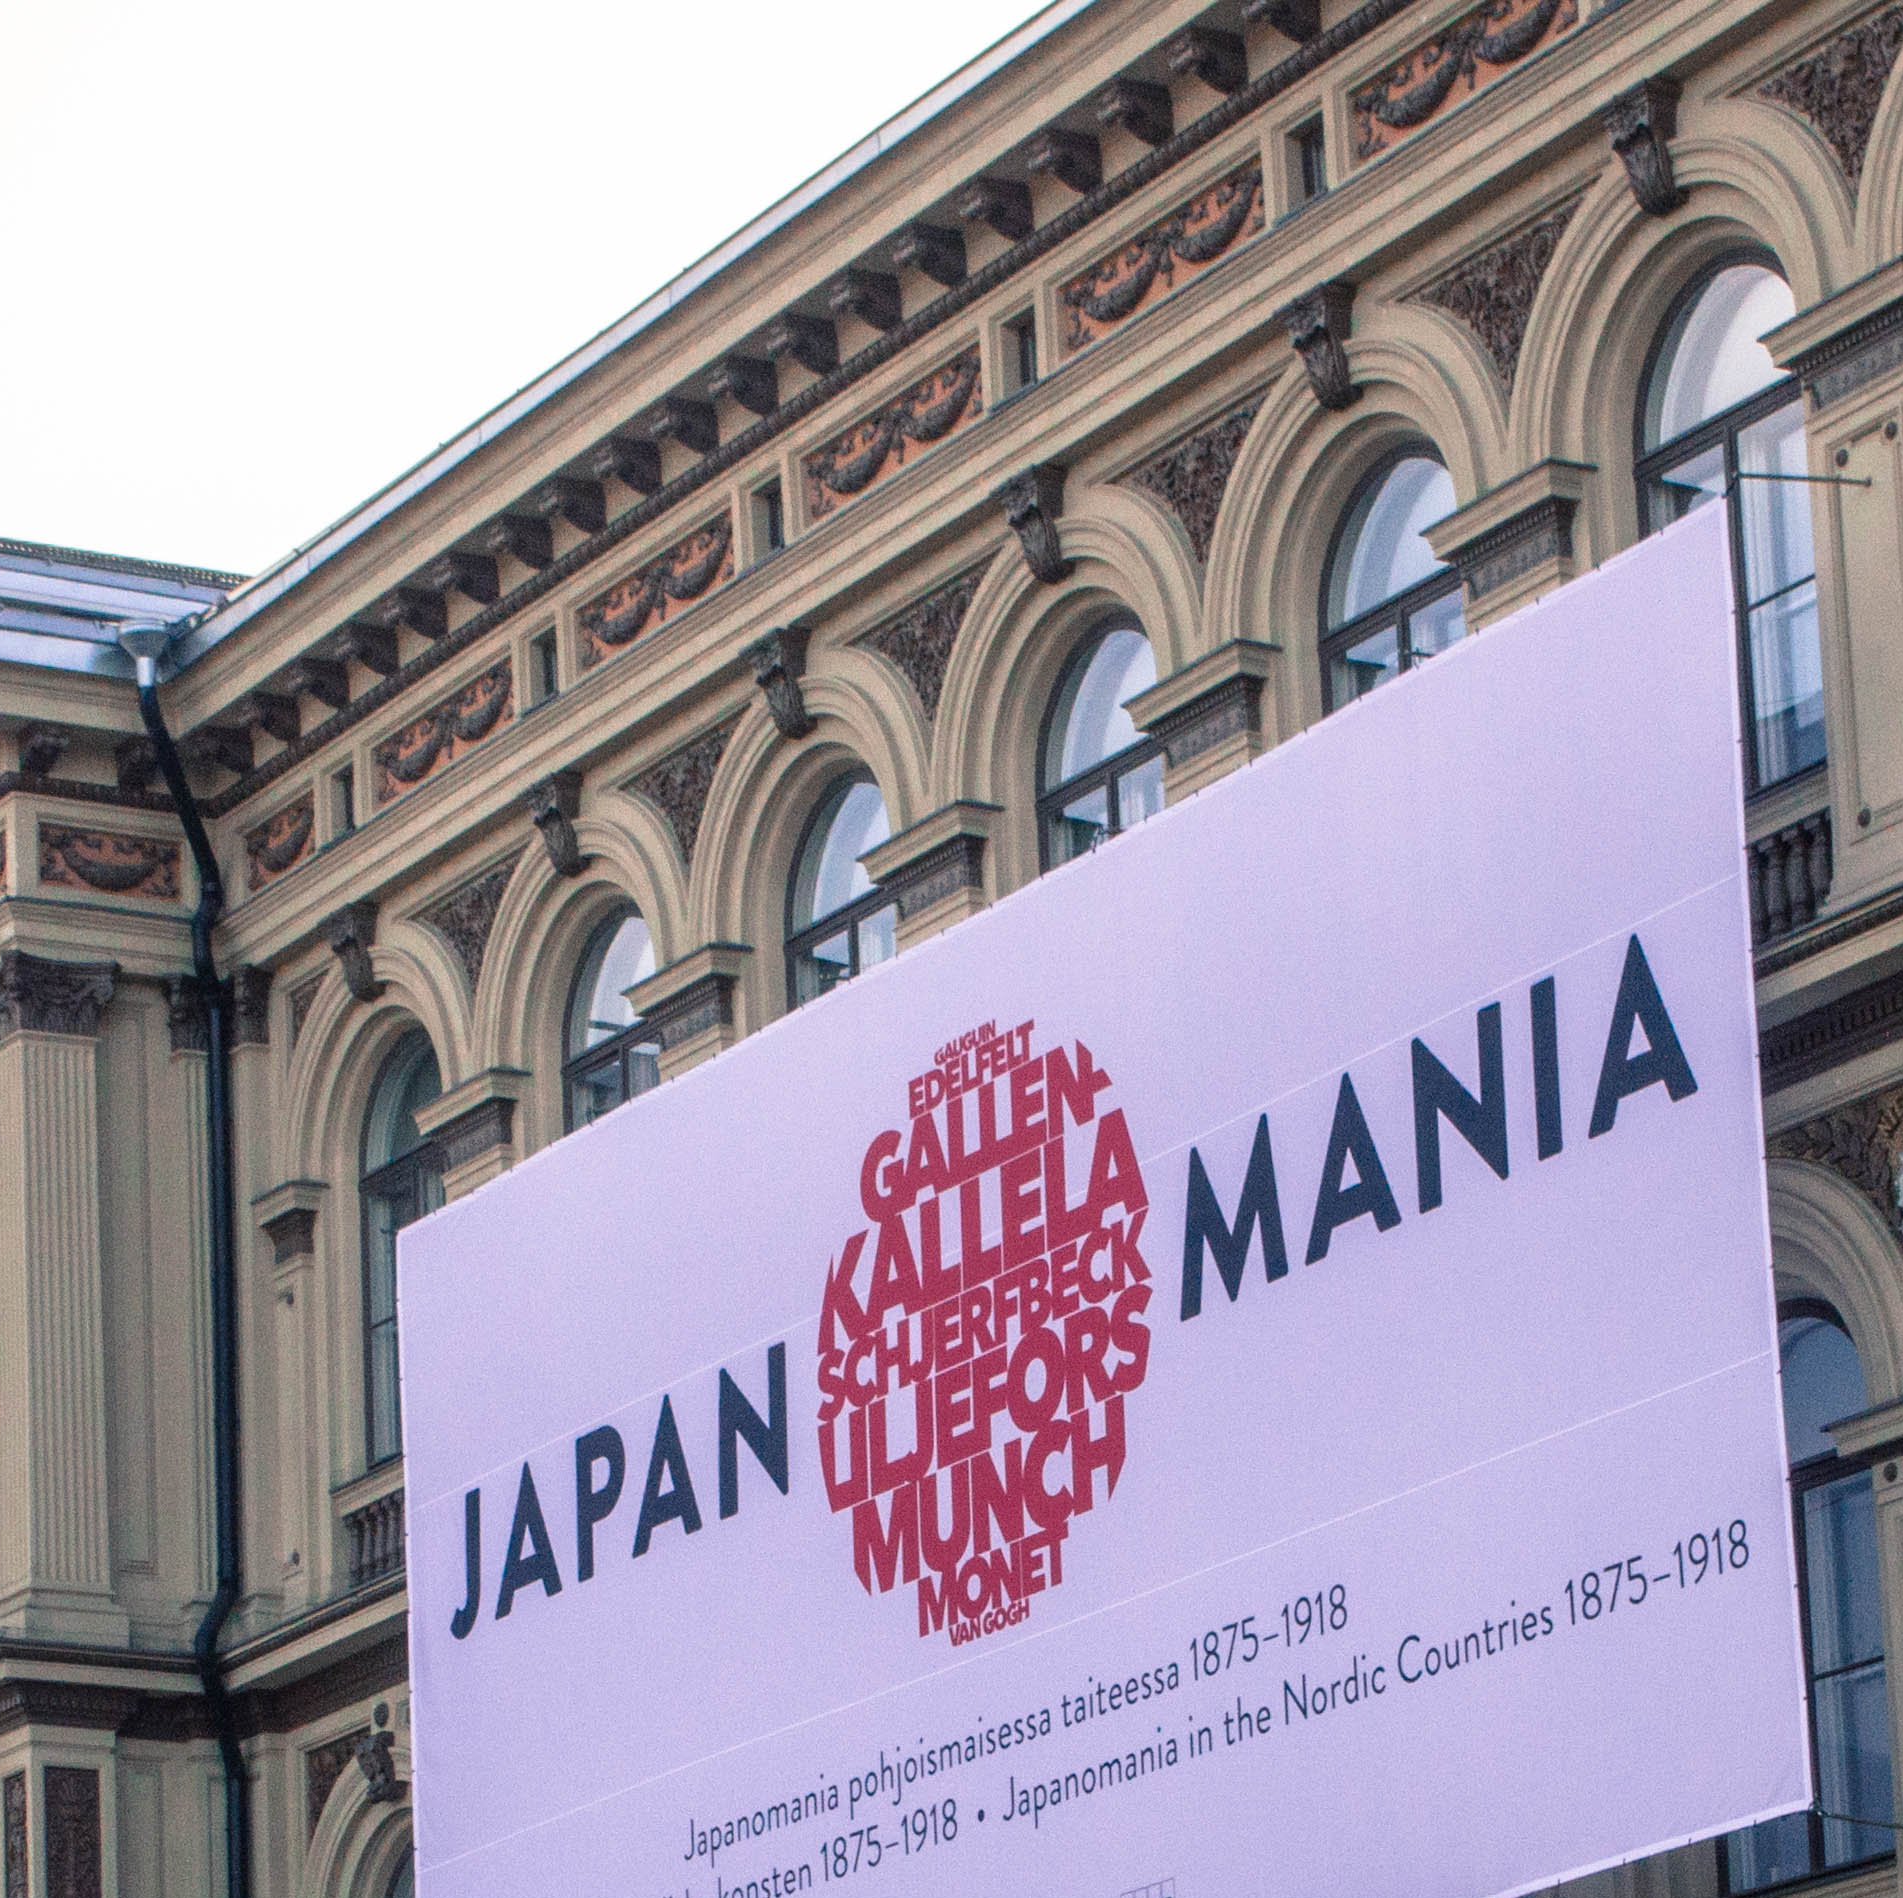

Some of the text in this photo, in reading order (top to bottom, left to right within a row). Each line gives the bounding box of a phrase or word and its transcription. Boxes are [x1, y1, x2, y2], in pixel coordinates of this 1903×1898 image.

[860, 1038, 1112, 1224] GALLEN-
[907, 1019, 1036, 1120] EDELFELT
[933, 1019, 997, 1066] GAUGUIN
[450, 940, 1699, 1641] JAPAN MANIA
[817, 1107, 1149, 1355] KALLELA
[817, 1208, 1152, 1422] SCHJERFBECK
[817, 1284, 1153, 1514] LILJEFORS
[852, 1393, 1127, 1596] MUNCH
[917, 1521, 1069, 1637] MONET
[949, 1597, 1030, 1647] VAN GOGH
[684, 1774, 840, 1867] Japanomania
[849, 1705, 1052, 1821] pohjoismaisessa
[1060, 1655, 1181, 1728] taiteessa
[1002, 1727, 1179, 1829] Japanomania
[1188, 1716, 1214, 1759] in
[1223, 1696, 1272, 1749] the
[1282, 1654, 1387, 1726] Nordic
[1396, 1600, 1554, 1684] Countries
